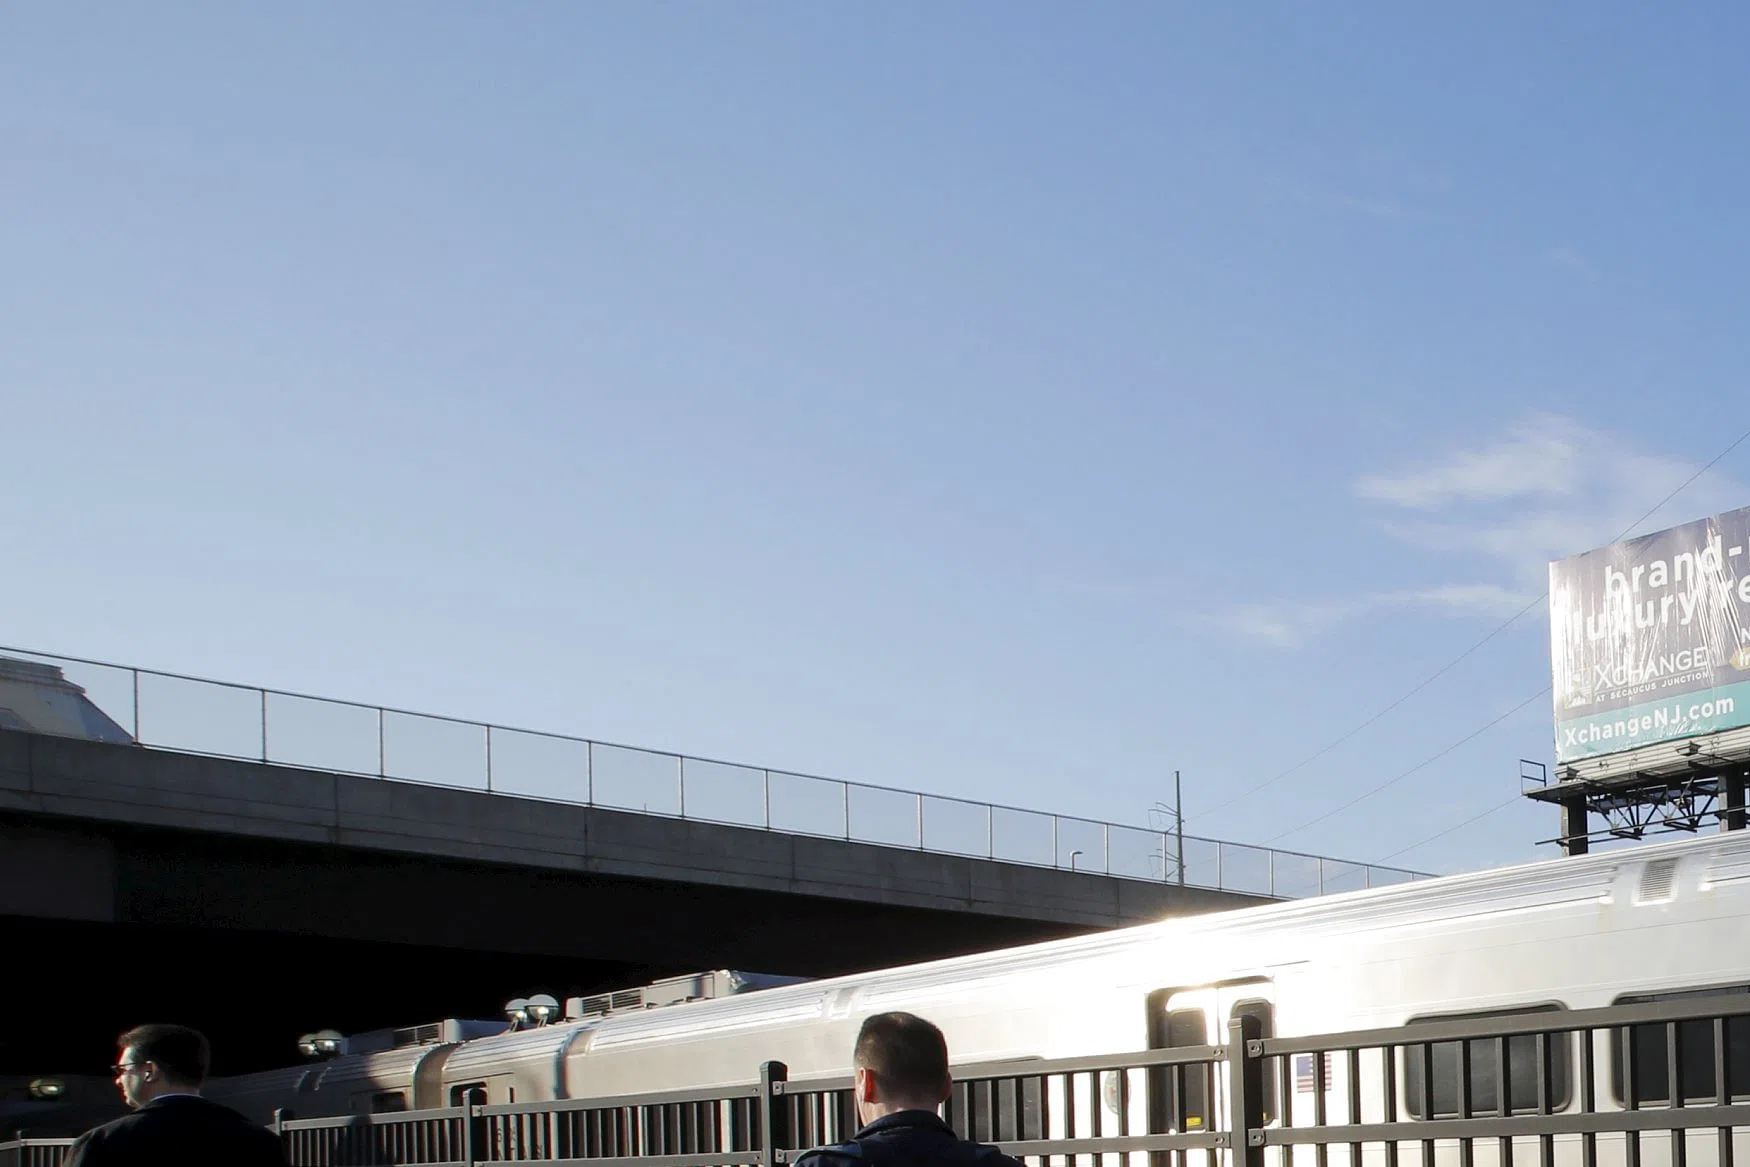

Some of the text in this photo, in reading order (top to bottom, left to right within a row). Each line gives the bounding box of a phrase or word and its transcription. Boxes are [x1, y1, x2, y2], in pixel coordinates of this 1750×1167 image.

[1572, 586, 1700, 645] luury
[1593, 647, 1708, 691] XCHANGE
[1595, 671, 1709, 703] AT SECAUCUS JUNCTION
[1564, 697, 1735, 747] XchangeNJ.com
